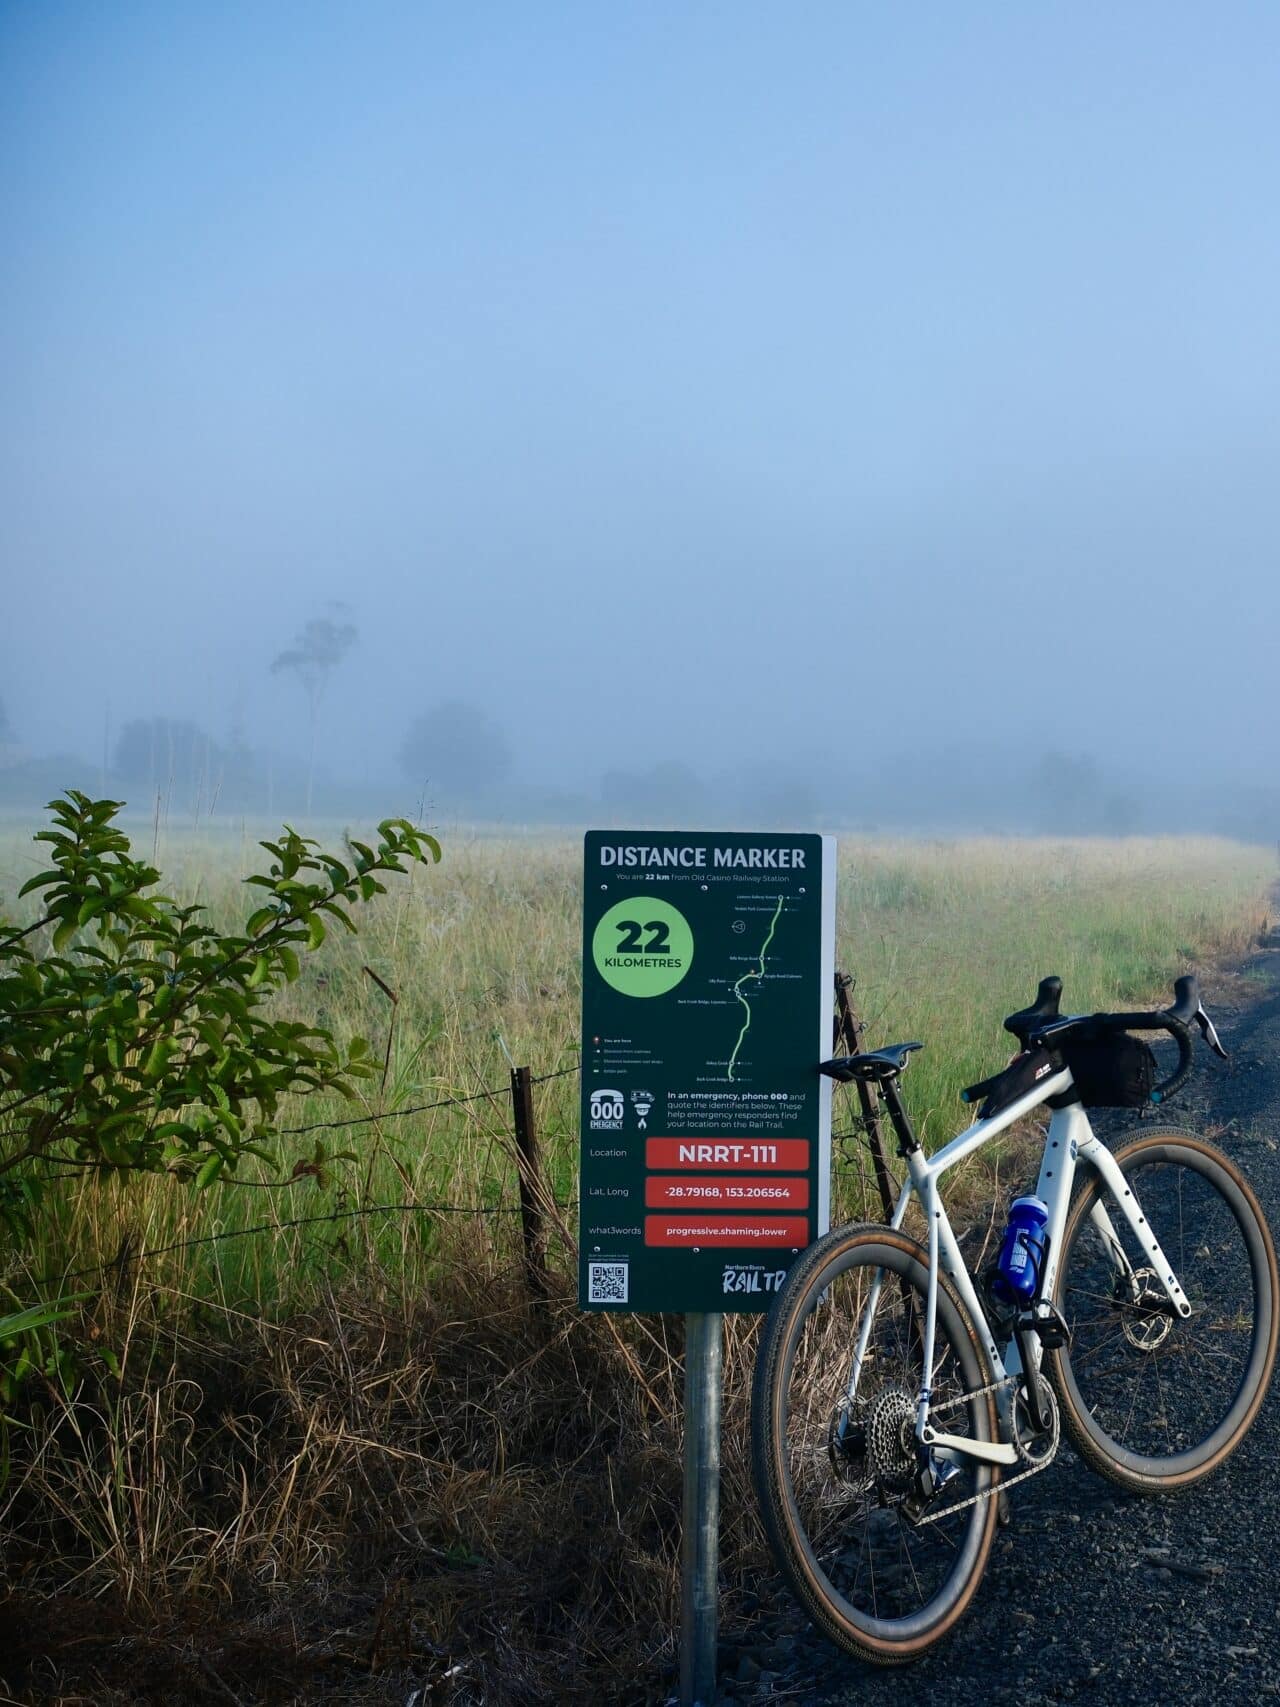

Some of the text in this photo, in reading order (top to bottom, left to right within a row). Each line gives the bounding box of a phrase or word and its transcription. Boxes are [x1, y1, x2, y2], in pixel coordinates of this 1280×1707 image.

[600, 846, 806, 869] DISTANCE MARKER
[706, 874, 732, 882] Casino
[732, 874, 763, 883] Railway
[615, 920, 671, 954] 22
[604, 957, 682, 969] KILOMETRES
[742, 1093, 769, 1101] phone
[790, 1093, 806, 1101] and
[590, 1102, 624, 1120] 000
[667, 1102, 691, 1110] quote
[709, 1102, 750, 1110] identifiers
[667, 1111, 798, 1120] help emergency responders find
[590, 1120, 623, 1129] EMERGENCY
[667, 1121, 686, 1129] your
[687, 1120, 719, 1128] location
[733, 1120, 747, 1128] the
[748, 1120, 763, 1128] Rail
[765, 1120, 784, 1128] Trail.
[590, 1148, 627, 1157] Location
[679, 1144, 777, 1163] NRRT-111
[607, 1187, 629, 1198] Long
[665, 1187, 790, 1199] -28.79168, 153.206564
[588, 1226, 642, 1236] what3words
[666, 1226, 787, 1238] progressive.shaming.lower
[722, 1270, 762, 1294] RAIL
